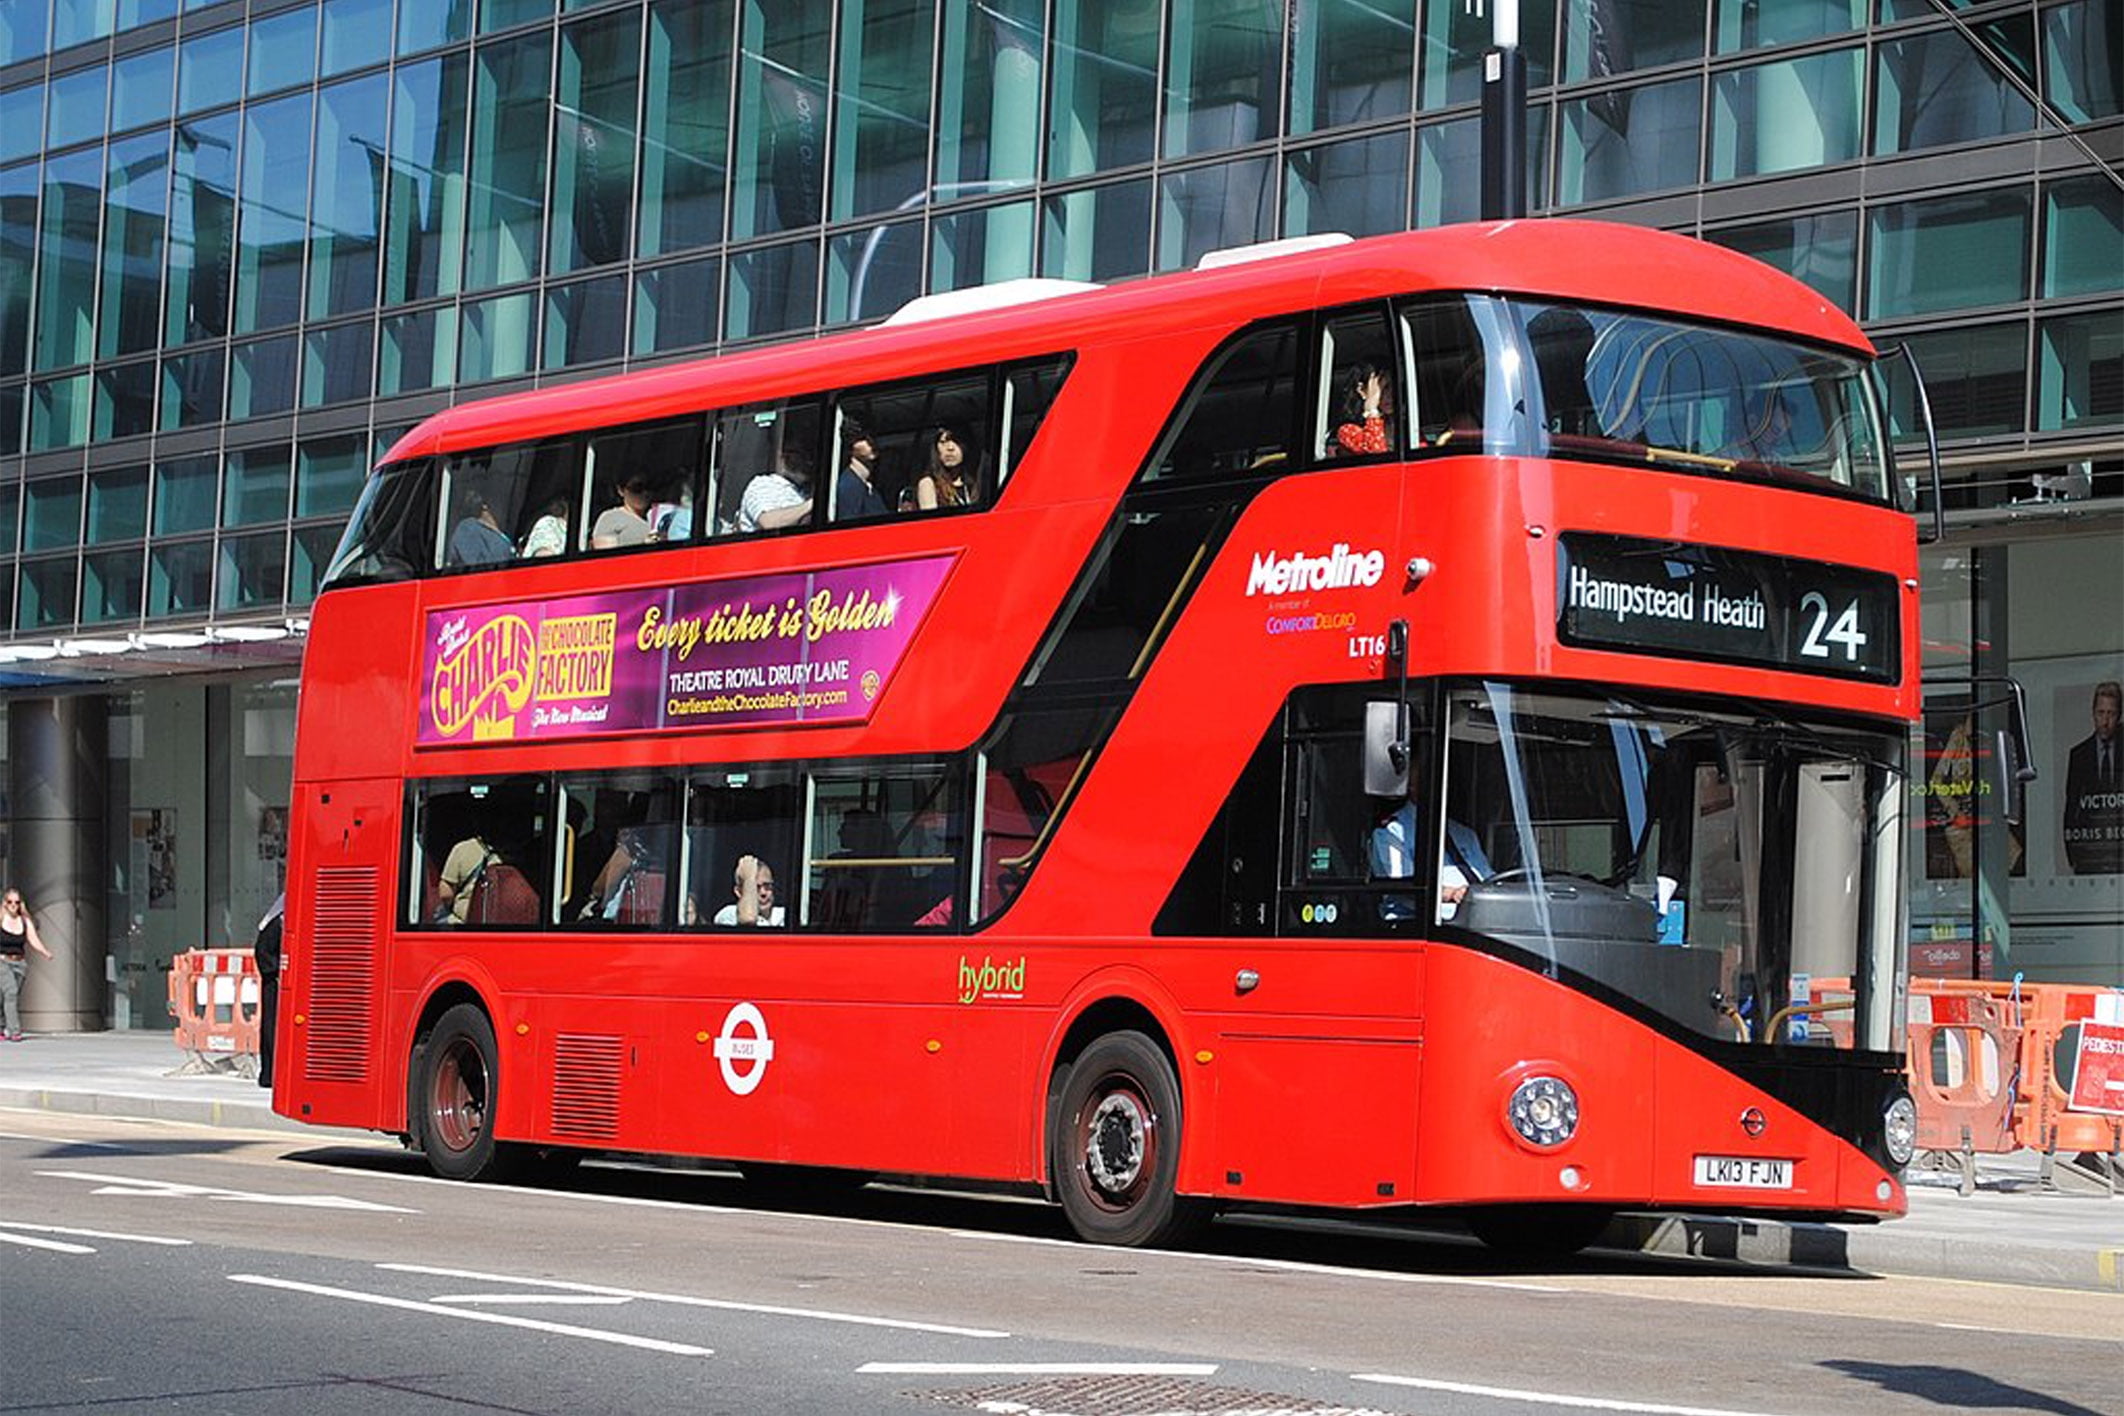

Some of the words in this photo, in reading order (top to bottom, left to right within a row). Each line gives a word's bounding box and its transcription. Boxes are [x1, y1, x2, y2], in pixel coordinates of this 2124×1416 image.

[1245, 543, 1385, 596] Metroline
[1569, 565, 1694, 622] Hampstead
[1704, 583, 1765, 629] Heath
[551, 618, 613, 650] CHOCOLATE
[637, 606, 700, 661] Every
[704, 602, 776, 643] ticket
[777, 598, 803, 638] is
[807, 589, 895, 641] Golden
[1349, 635, 1386, 658] LT16
[1800, 591, 1867, 661] 24
[433, 617, 534, 730] CHARLIE
[537, 648, 611, 696] FACTORY
[669, 669, 723, 693] THEATRE
[725, 666, 766, 690] ROYAL
[769, 664, 815, 686] DRURY
[814, 660, 849, 684] LANE
[667, 690, 847, 716] CharlieandtheChocolateFactory.com
[958, 955, 1025, 1004] hybrid
[1706, 1160, 1743, 1182] LK13
[1750, 1162, 1783, 1184] FJN
